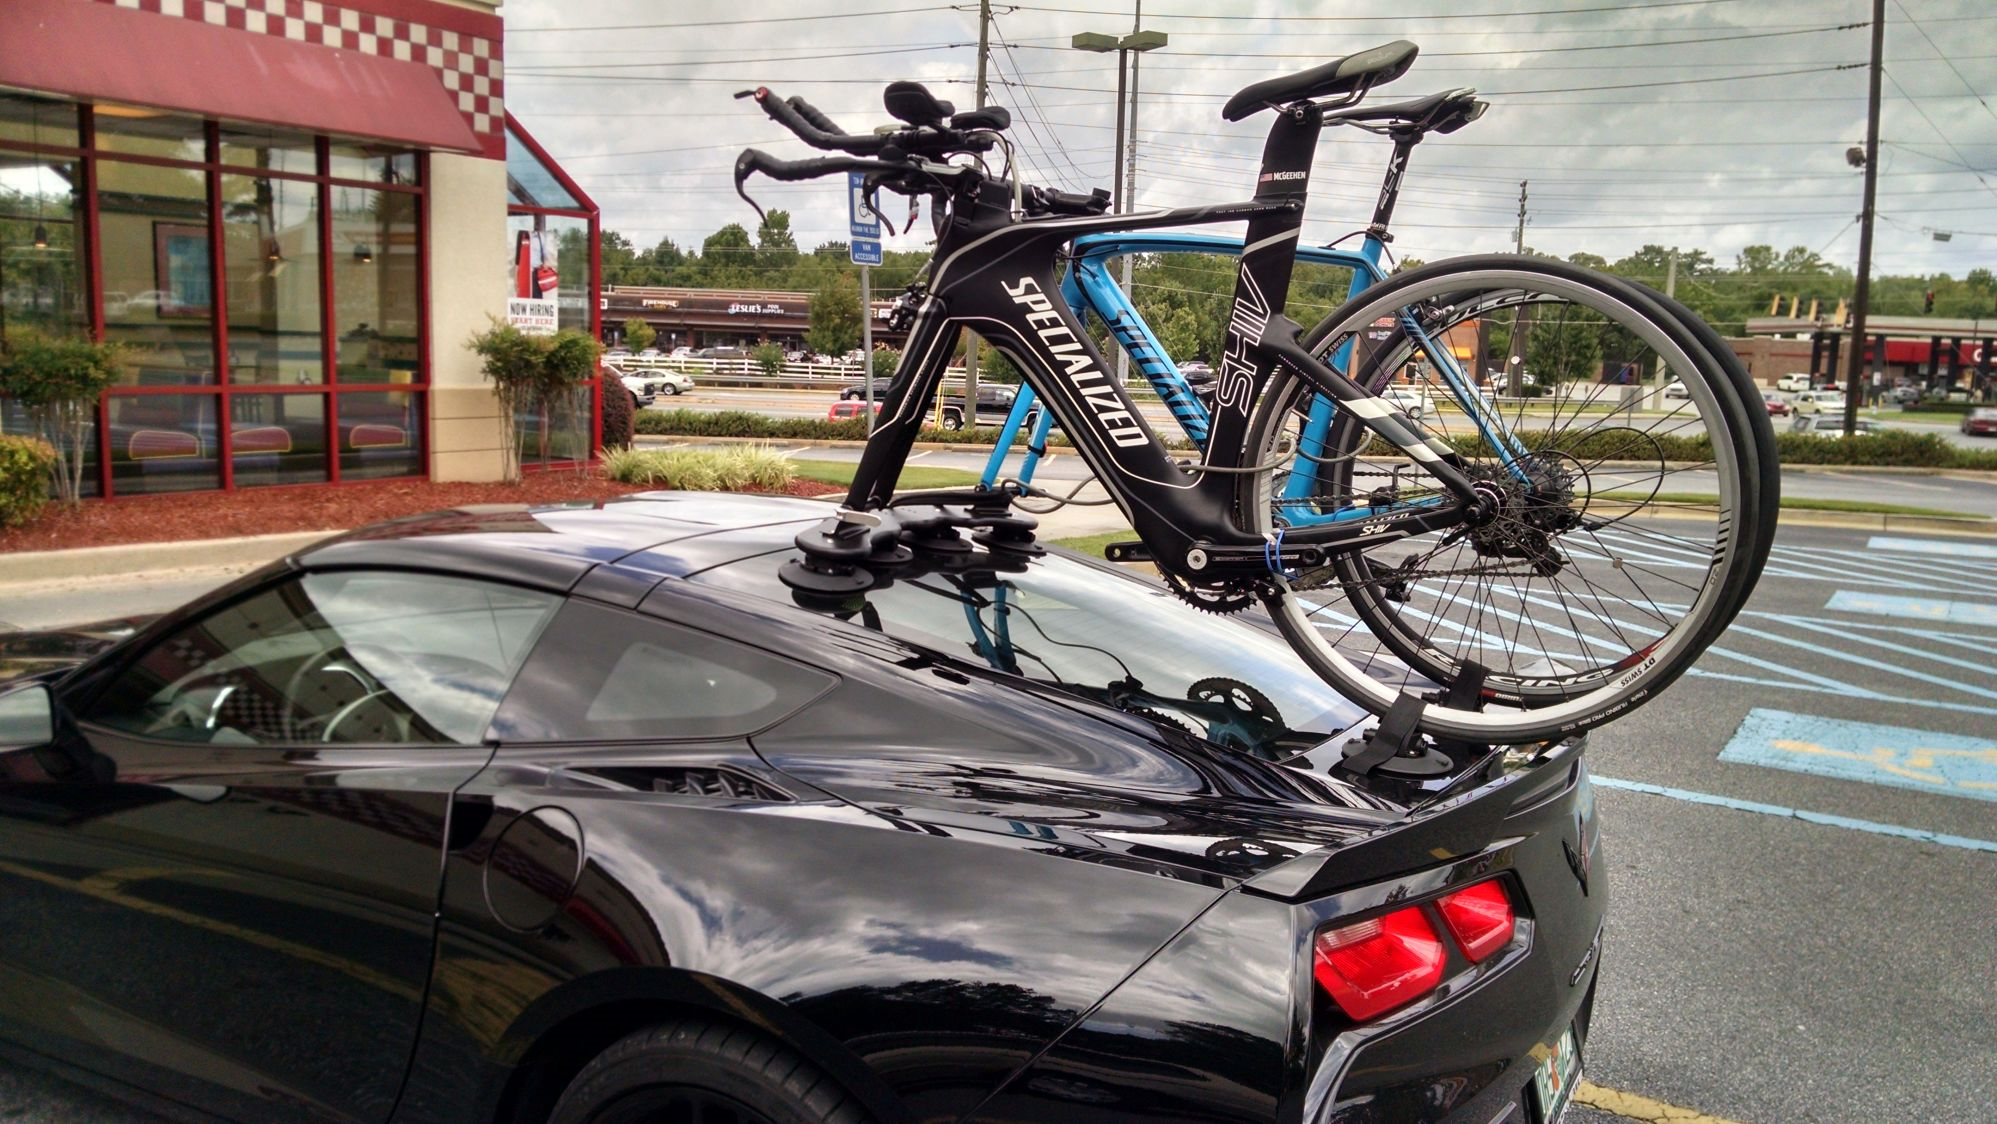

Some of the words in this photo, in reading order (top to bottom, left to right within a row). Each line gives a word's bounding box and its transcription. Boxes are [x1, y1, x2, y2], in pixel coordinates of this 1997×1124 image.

[862, 244, 871, 252] VAN
[854, 252, 879, 262] ACCESSIBLE
[510, 303, 527, 316] NOW
[529, 304, 554, 317] HIRING
[731, 303, 761, 314] LESLIE'S
[1216, 262, 1270, 417] SHIV
[1001, 276, 1149, 448] SPECIALIZED
[1101, 309, 1208, 450] SPECIALIZ
[1359, 523, 1391, 537] SHIV
[1643, 656, 1657, 671] DT
[1620, 668, 1643, 688] SWISS
